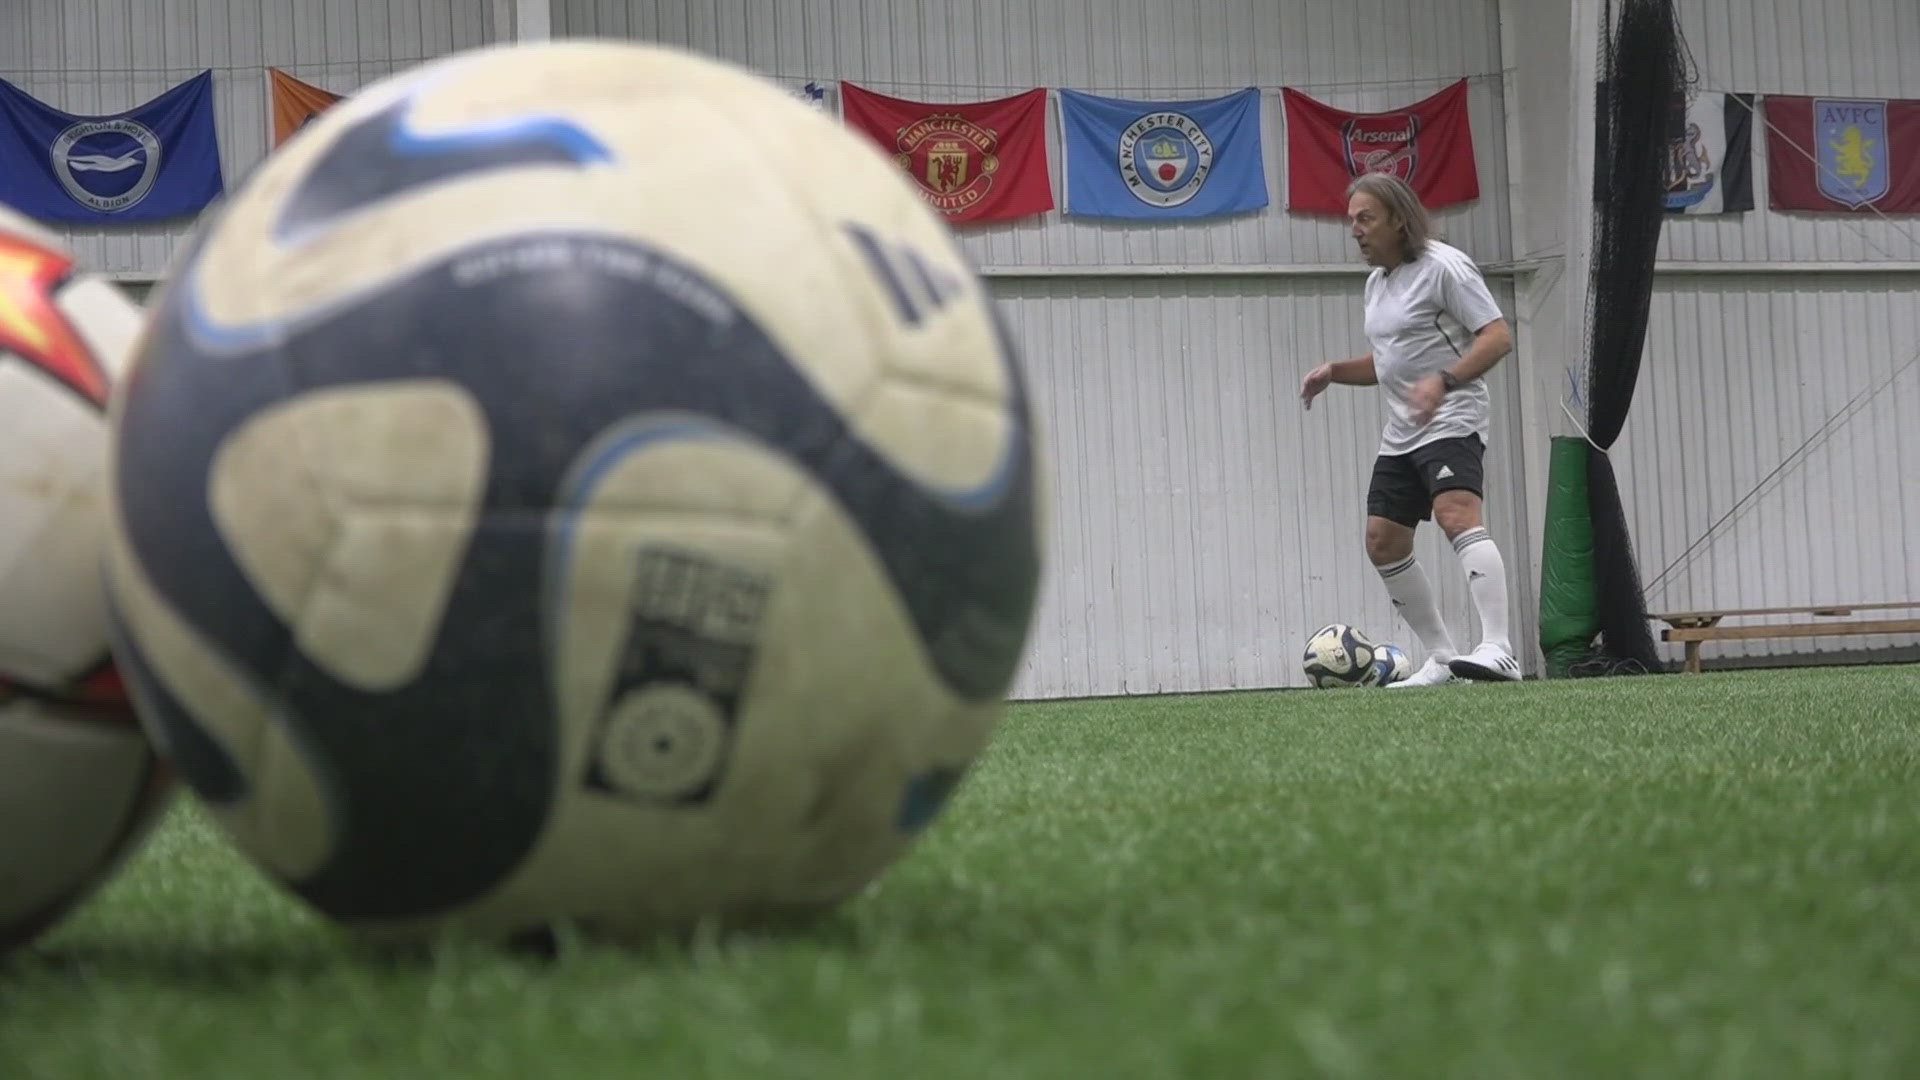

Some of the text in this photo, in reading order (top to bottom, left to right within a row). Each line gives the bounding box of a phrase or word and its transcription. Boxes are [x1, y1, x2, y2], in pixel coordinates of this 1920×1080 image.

[1823, 107, 1878, 124] AVFC
[62, 121, 111, 145] BRIGHTON
[905, 119, 991, 149] MANCHESTER
[1350, 126, 1411, 143] Arsenal
[1122, 115, 1185, 187] MANCHESTER
[1187, 127, 1210, 157] CITY
[88, 196, 129, 208] ALBION
[919, 189, 978, 208] UNITED
